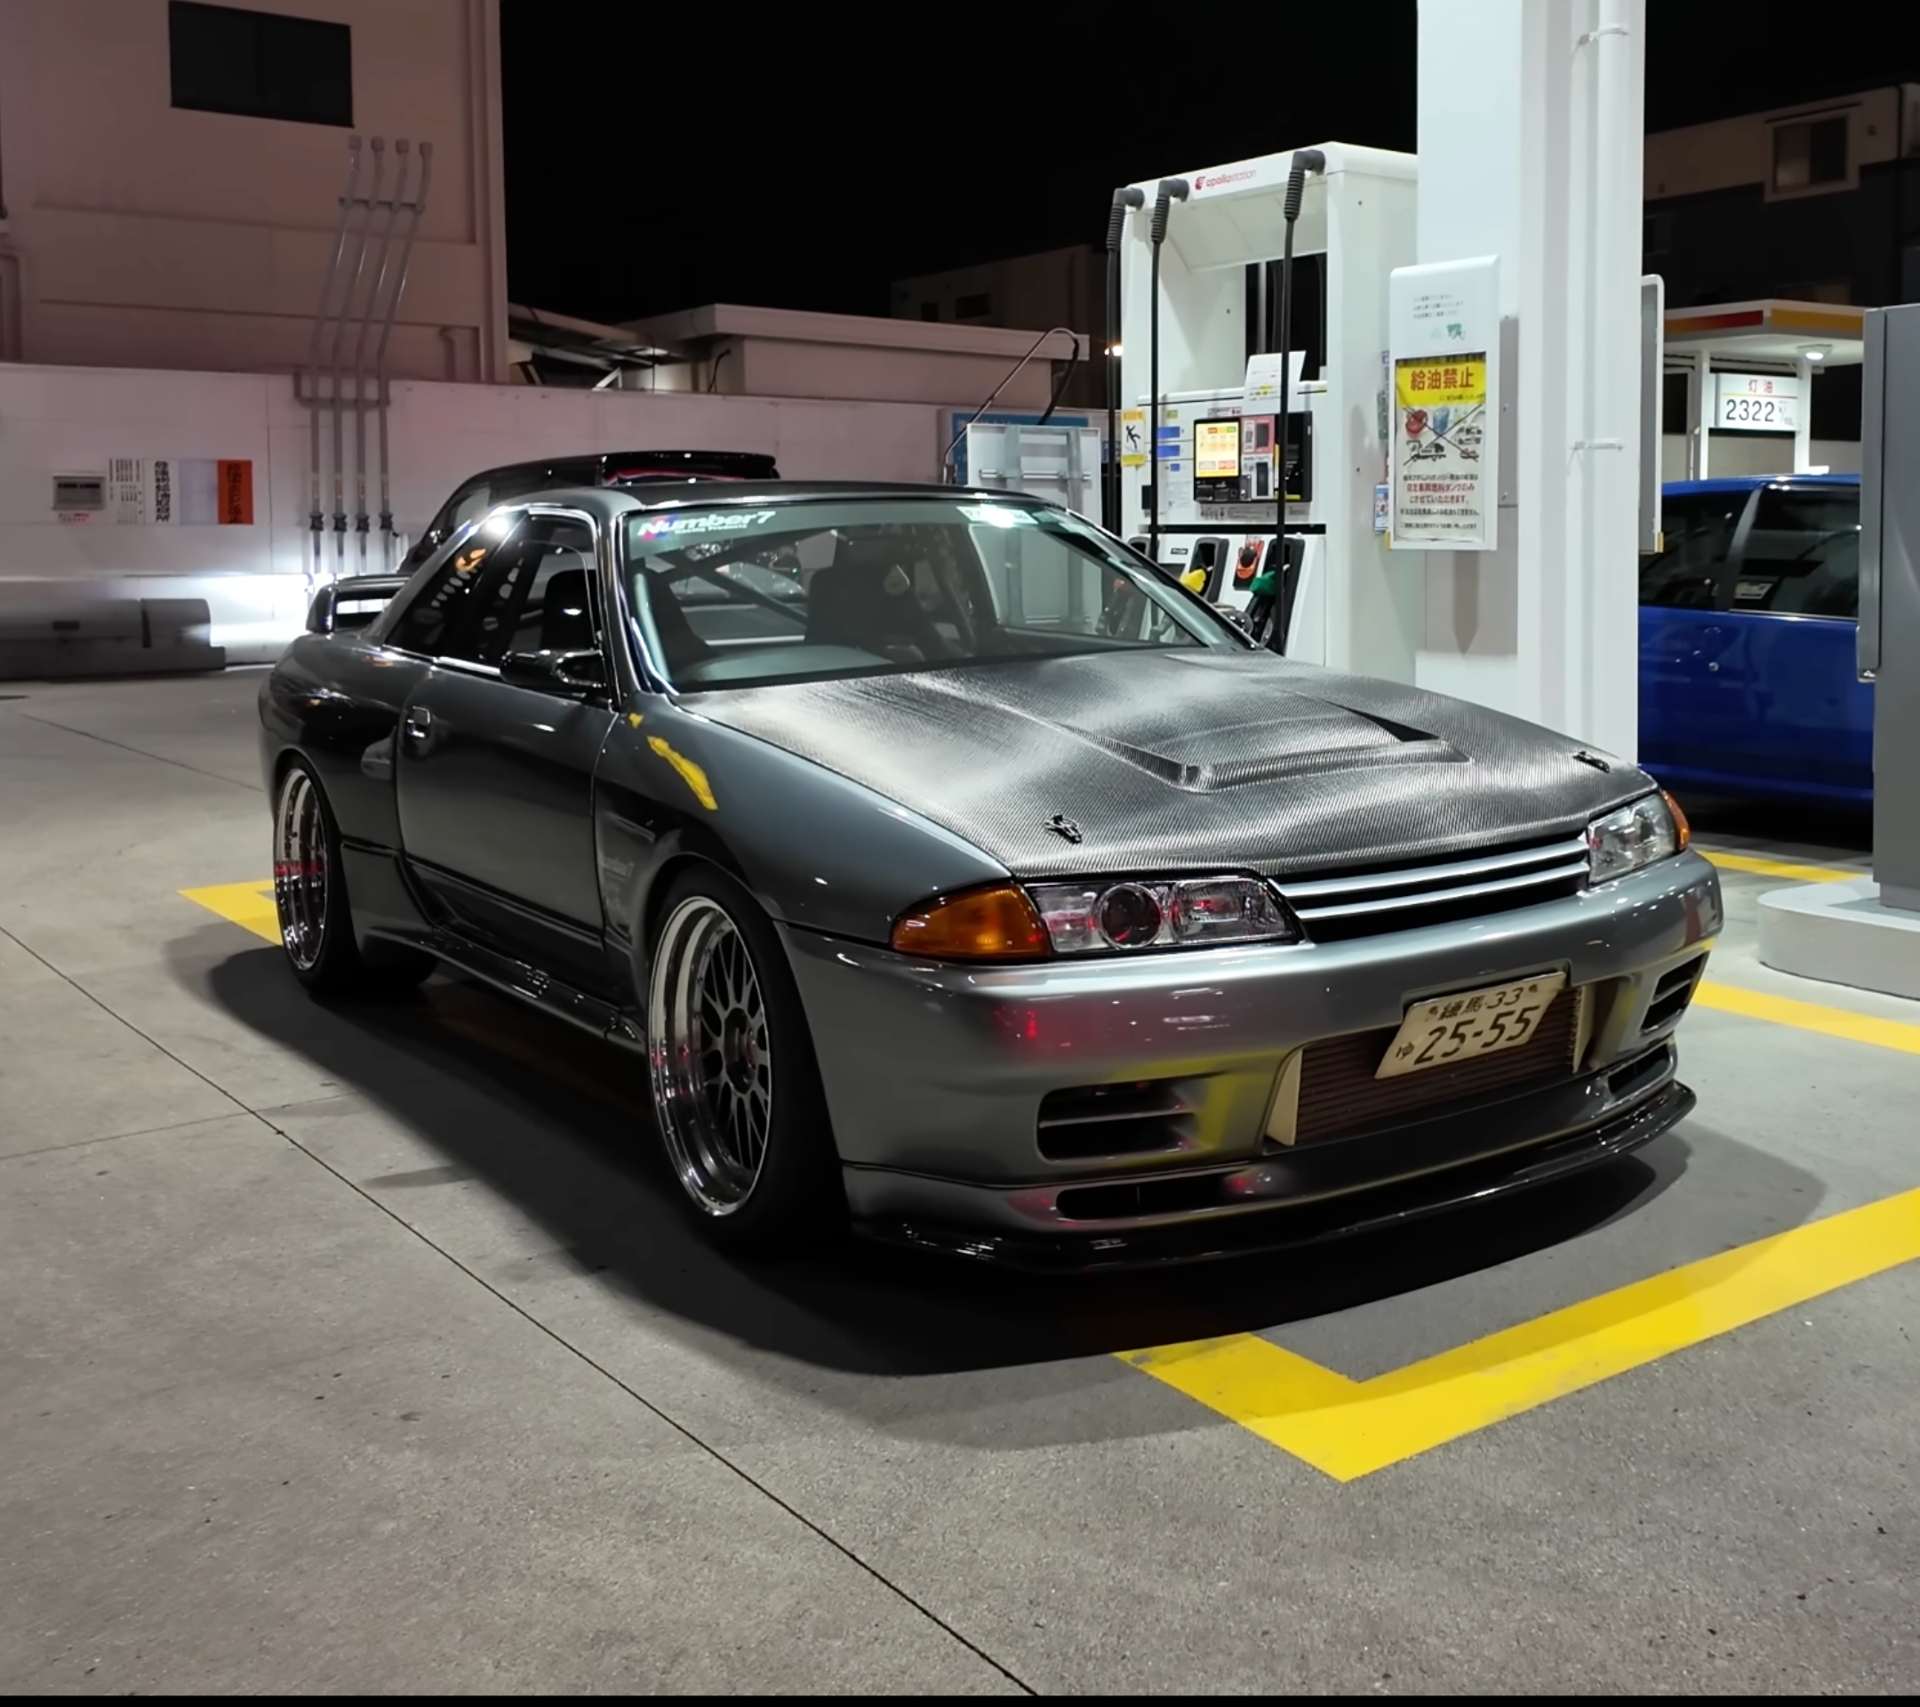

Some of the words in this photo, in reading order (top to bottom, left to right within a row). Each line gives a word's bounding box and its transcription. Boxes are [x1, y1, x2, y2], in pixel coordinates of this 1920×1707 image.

[1206, 169, 1257, 188] apollostation
[1410, 366, 1474, 392] 給油禁止
[1748, 379, 1774, 394] 灯油
[1725, 399, 1775, 422] 2322
[1438, 995, 1485, 1021] 練馬
[1487, 987, 1524, 1010] 33
[1395, 1042, 1415, 1060] ゆ
[1413, 1005, 1540, 1066] 25-55
